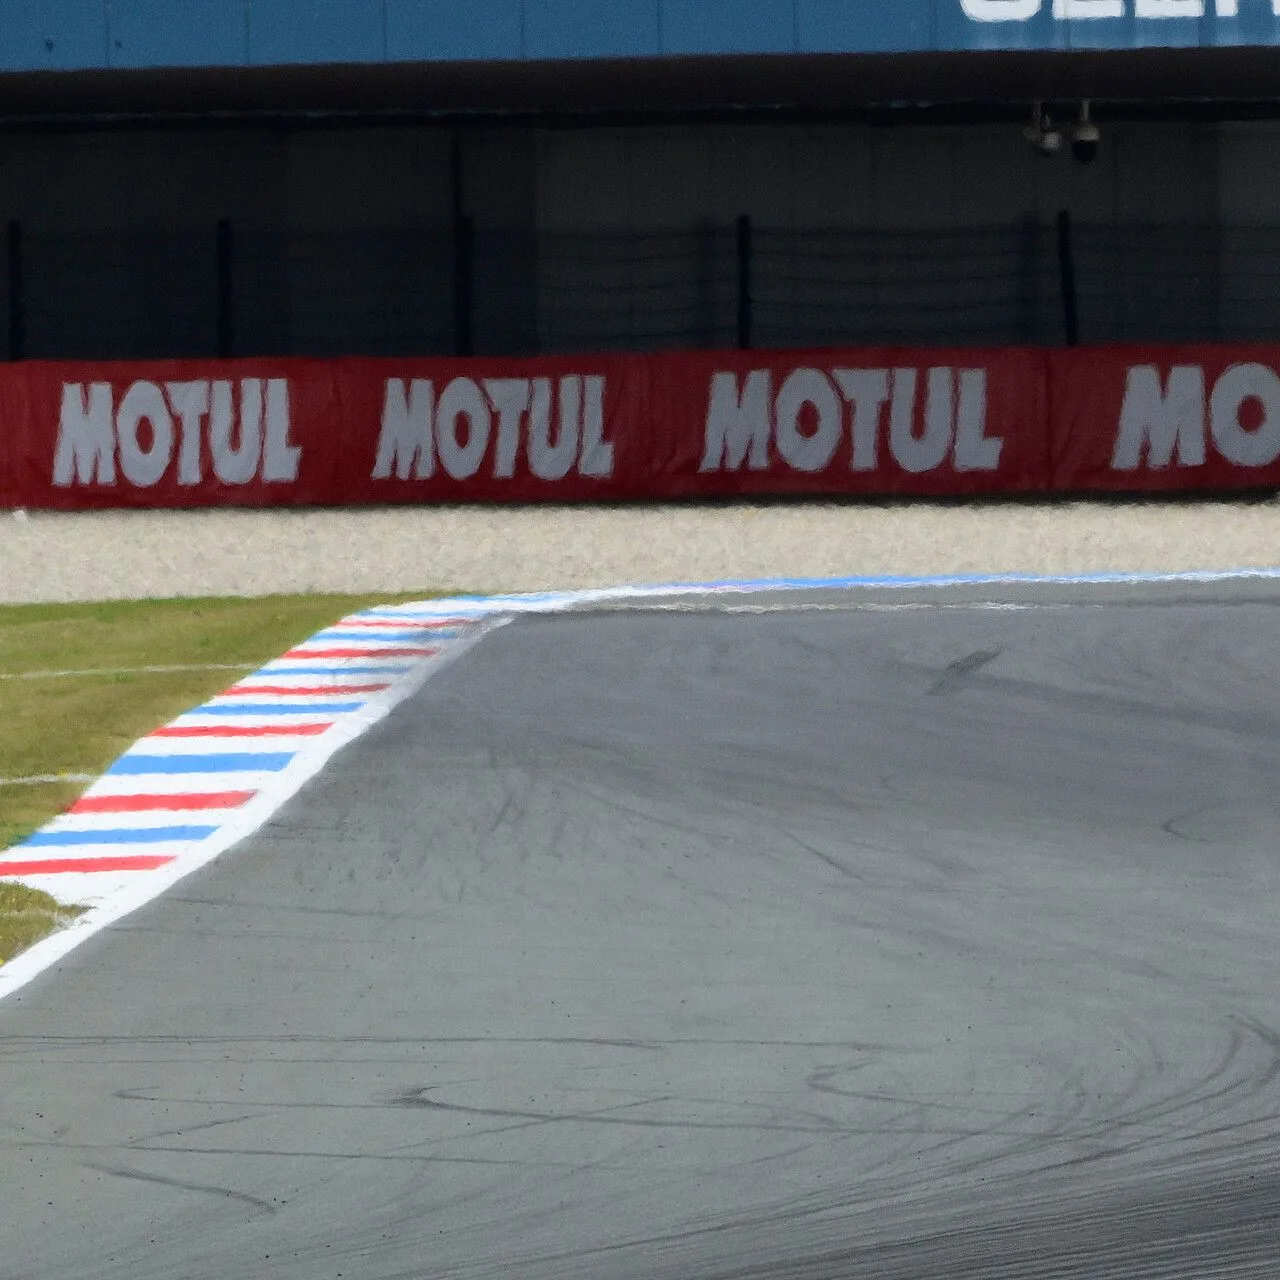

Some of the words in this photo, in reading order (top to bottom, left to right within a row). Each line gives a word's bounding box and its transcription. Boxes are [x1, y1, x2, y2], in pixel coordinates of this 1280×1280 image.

[52, 377, 301, 488] MOTUL
[371, 375, 614, 480] MOTUL
[699, 366, 1002, 473] MOTUL
